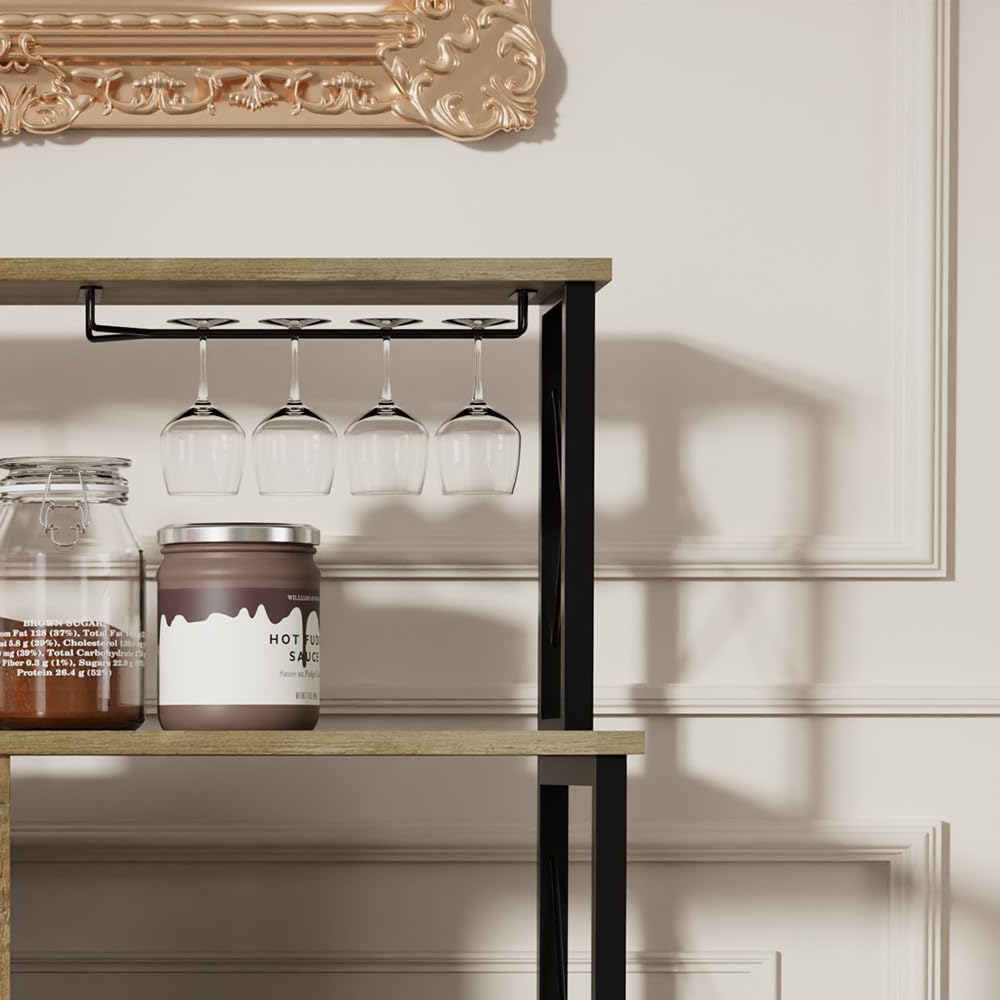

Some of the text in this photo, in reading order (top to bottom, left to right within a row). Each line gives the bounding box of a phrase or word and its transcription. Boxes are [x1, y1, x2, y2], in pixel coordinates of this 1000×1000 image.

[13, 629, 28, 637] Fat
[269, 634, 300, 645] HOT
[47, 649, 75, 657] Total
[289, 650, 320, 663] SAUCE
[2, 659, 25, 667] Fiber
[17, 669, 53, 677] Protein
[78, 670, 85, 678] g
